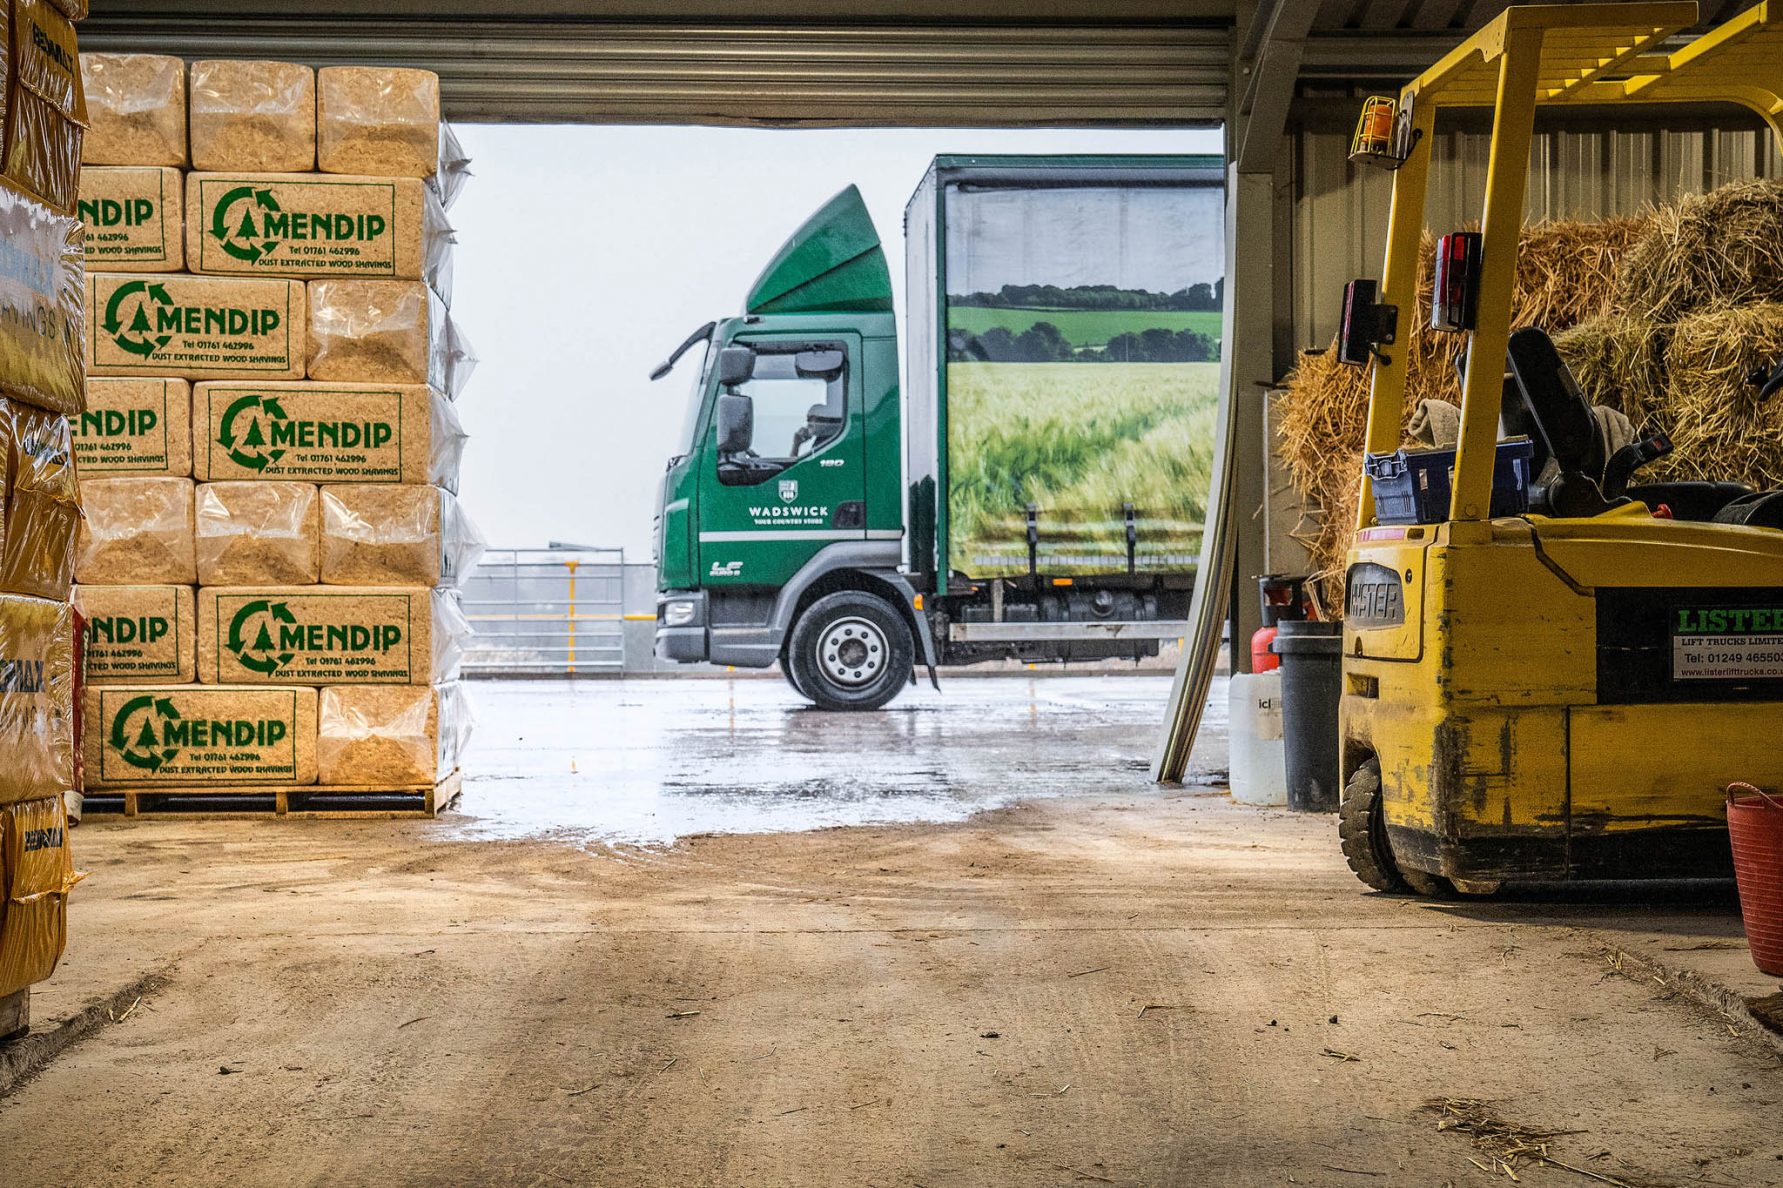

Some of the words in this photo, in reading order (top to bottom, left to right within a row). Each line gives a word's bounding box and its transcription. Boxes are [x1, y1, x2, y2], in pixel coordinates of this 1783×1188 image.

[263, 213, 386, 241] MENDIP
[97, 233, 129, 241] 462996
[97, 246, 123, 254] WOOD
[124, 246, 162, 254] SHAVINGS
[289, 246, 301, 254] Tel
[303, 247, 326, 255] 01761
[329, 247, 360, 255] 462996
[280, 259, 326, 267] EXTRACTED
[156, 307, 280, 336] MENDIP
[182, 340, 195, 349] Tel
[197, 341, 220, 349] 01761
[222, 341, 255, 350] 462996
[174, 353, 220, 362] EXTRACTED
[222, 355, 247, 363] WOOD
[270, 420, 392, 449] MENDIP
[74, 443, 97, 451] 01761
[100, 443, 132, 451] 462996
[127, 455, 164, 463] SHAVINGS
[296, 454, 308, 462] Tel
[310, 454, 333, 462] 01761
[335, 455, 367, 463] 462996
[287, 467, 333, 475] EXTRACTED
[361, 468, 399, 476] SHAVINGS
[748, 506, 829, 517] WADSWICK
[280, 625, 402, 651] MENDIP
[1681, 638, 1704, 646] LIFT
[1706, 638, 1746, 646] TRUCKS
[305, 657, 317, 665] Tel
[1685, 653, 1704, 664] Tel:
[1707, 653, 1742, 664] 01249
[297, 670, 342, 678] EXTRACTED
[345, 670, 369, 678] WOOD
[371, 670, 408, 678] SHAVINGS
[163, 719, 286, 746] MENDIP
[189, 753, 202, 761] Tel
[229, 753, 261, 761] 462996
[159, 766, 179, 774] DUST
[181, 766, 227, 774] EXTRACTED
